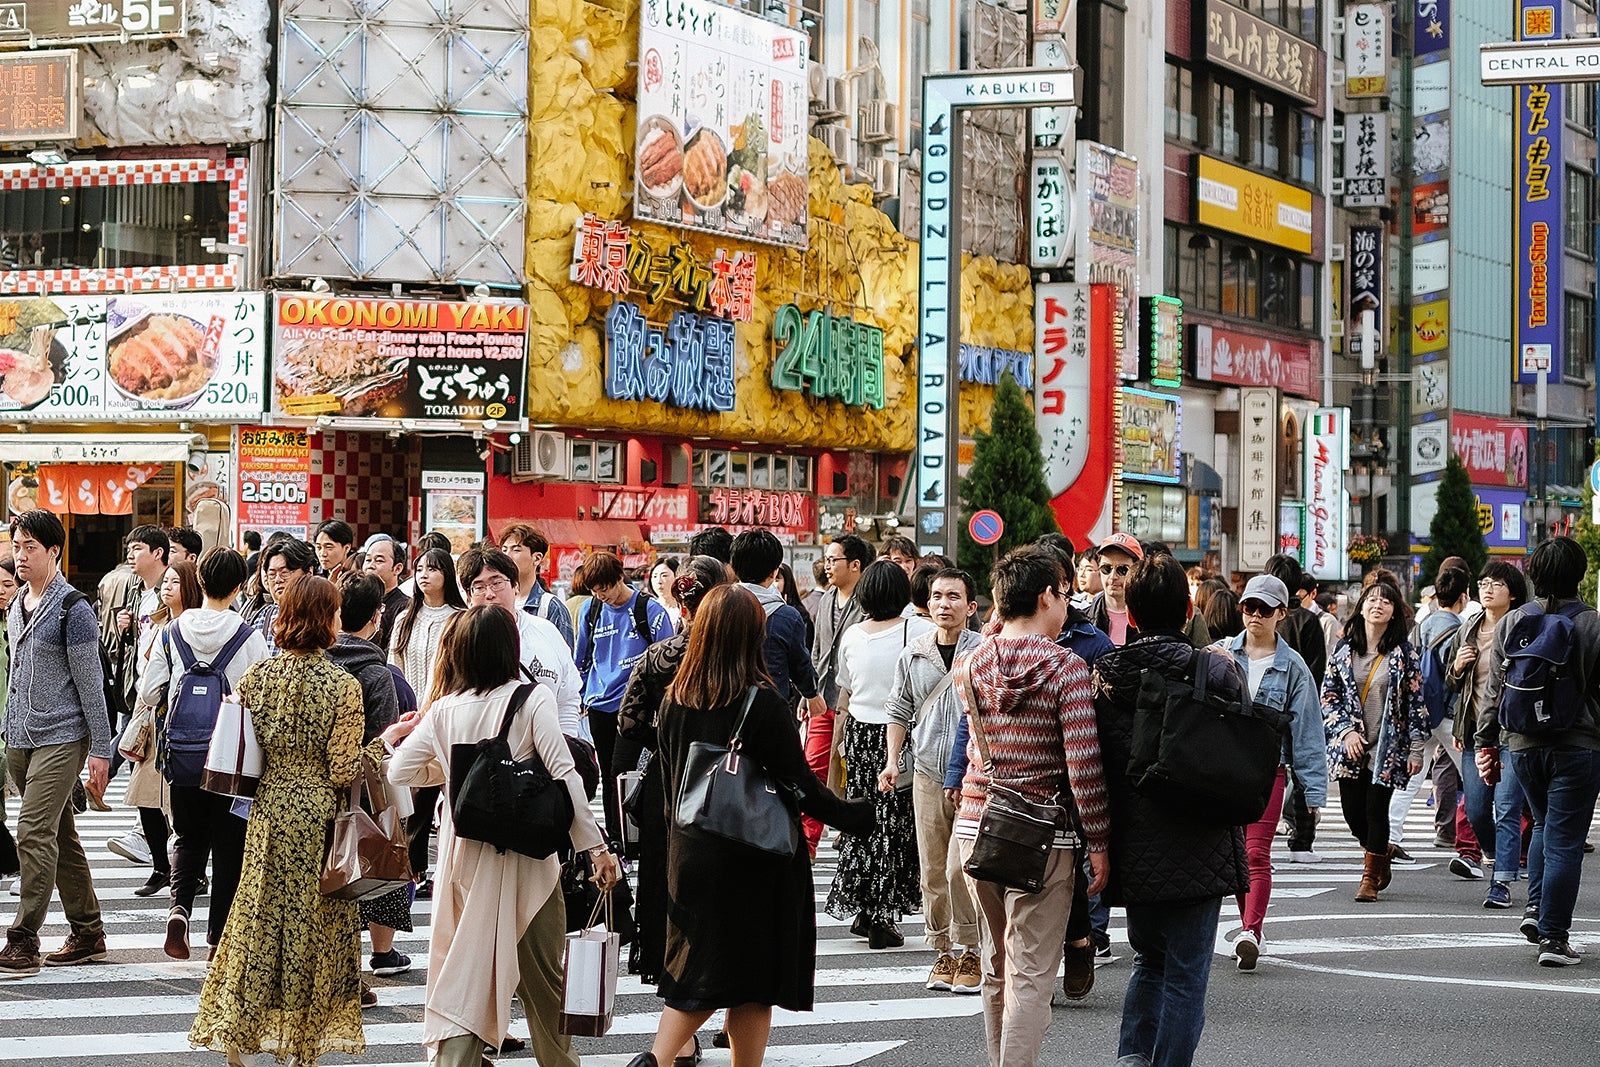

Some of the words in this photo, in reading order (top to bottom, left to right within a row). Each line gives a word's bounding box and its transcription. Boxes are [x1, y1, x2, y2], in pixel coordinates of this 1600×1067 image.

[1223, 12, 1302, 92] 山内農場
[1488, 57, 1569, 71] CENTRAL
[1037, 178, 1060, 238] かっぱ
[925, 144, 948, 346] GODZILLA
[1039, 246, 1057, 258] B1
[1355, 231, 1375, 290] 海の家
[65, 305, 80, 380] ラーメン
[84, 303, 101, 381] とんこつ
[232, 298, 256, 377] かつ丼
[281, 298, 438, 328] OKONOMI
[449, 302, 525, 331] YAKI
[419, 332, 446, 345] with
[1071, 288, 1087, 359] 大衆酒場
[377, 345, 416, 358] Drinks
[417, 346, 434, 359] for
[436, 346, 447, 359] 2
[448, 346, 483, 359] hours
[605, 301, 736, 412] 飲み放題
[772, 302, 885, 409] 24時間
[1042, 298, 1068, 416] トラノコ
[207, 382, 259, 405] 520円
[425, 405, 485, 416] TORADYU
[488, 406, 504, 416] 2F
[923, 373, 944, 469] ROAD
[241, 447, 285, 456] OKONOMI
[286, 448, 309, 457] YAKI
[242, 431, 308, 446] お好み焼き
[241, 482, 307, 503] 2,500円
